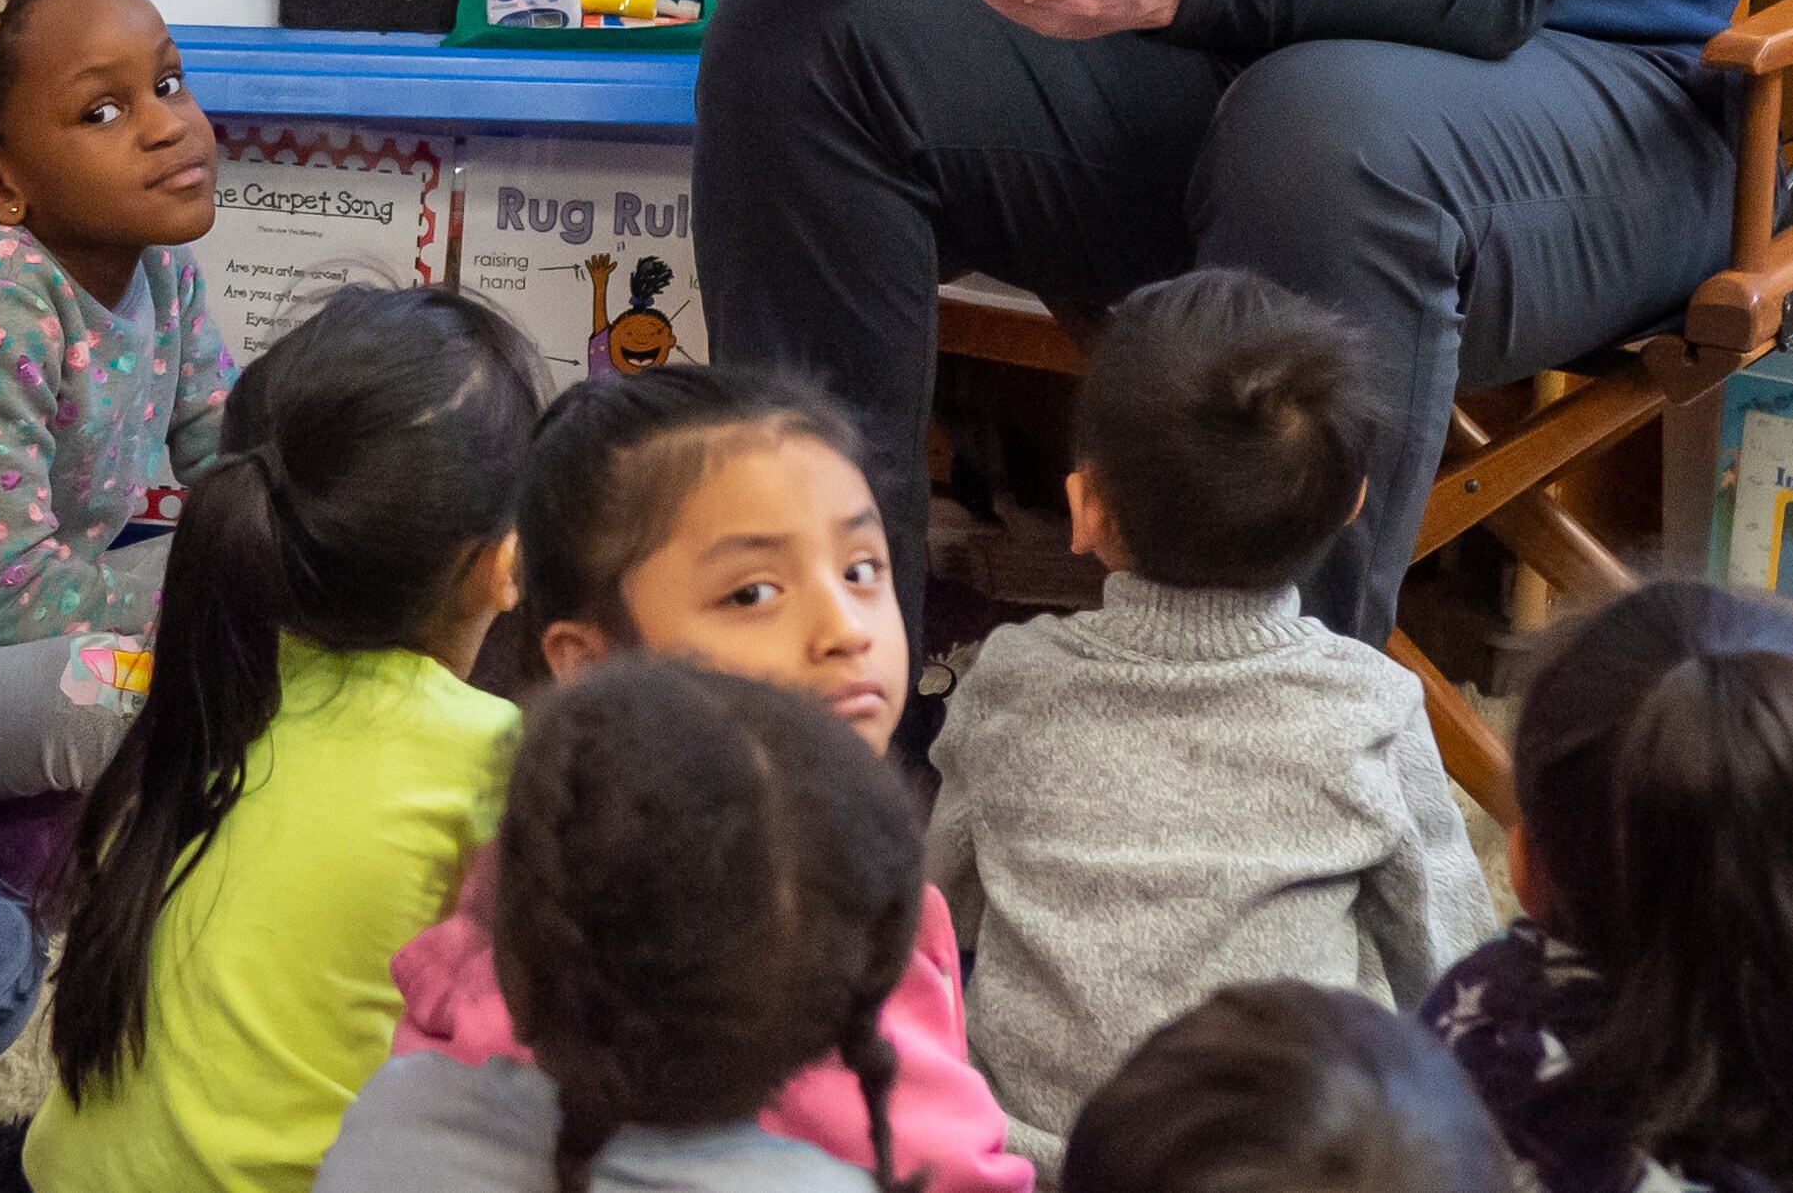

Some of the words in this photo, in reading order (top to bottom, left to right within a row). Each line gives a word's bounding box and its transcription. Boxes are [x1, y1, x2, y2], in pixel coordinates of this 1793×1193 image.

[243, 182, 331, 215] Carpet
[336, 190, 394, 225] Song
[496, 186, 594, 245] Rug
[613, 191, 689, 239] Rul
[226, 259, 249, 274] Are
[251, 264, 273, 277] you
[473, 253, 529, 271] raising
[479, 274, 526, 290] hand
[223, 284, 248, 299] Are
[243, 336, 270, 352] Eye
